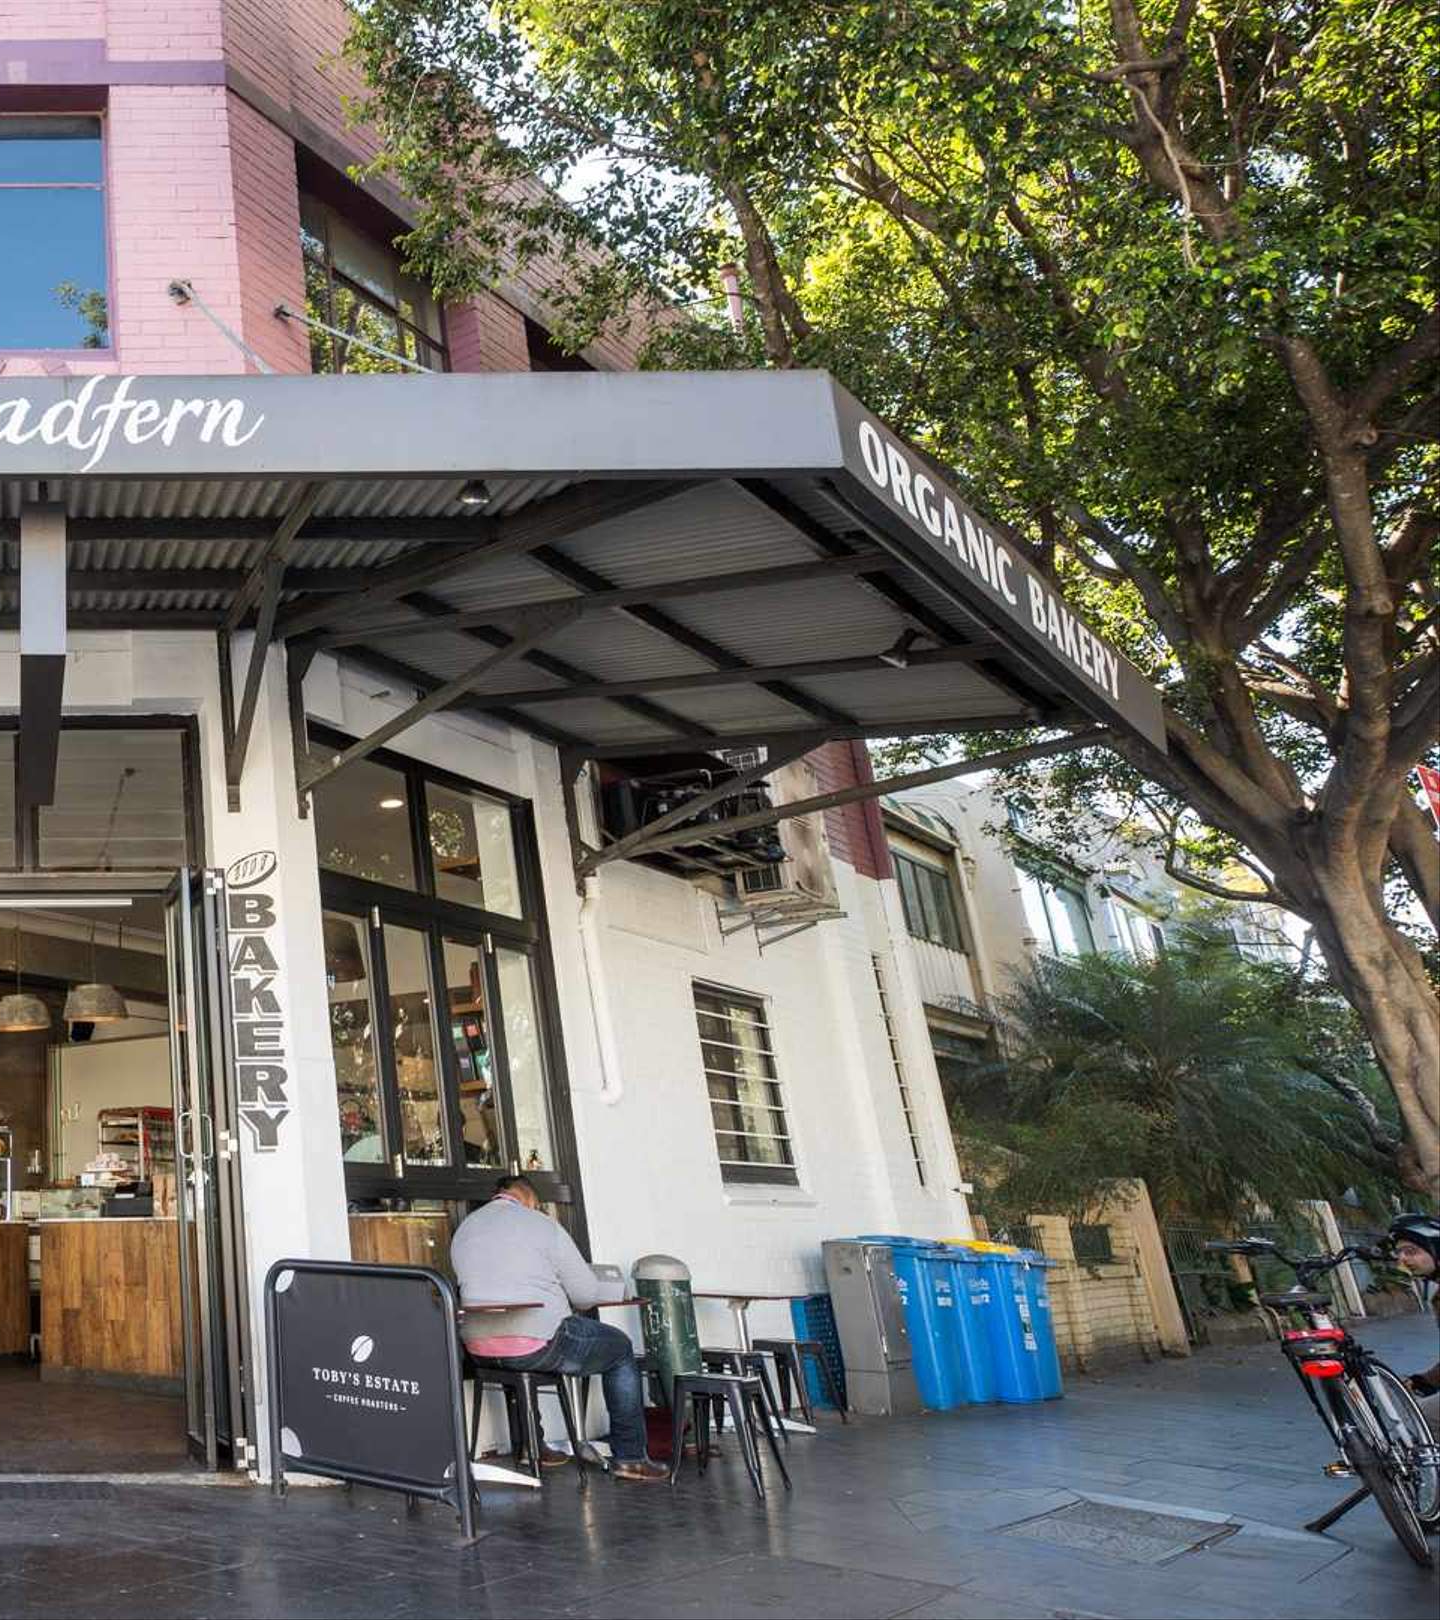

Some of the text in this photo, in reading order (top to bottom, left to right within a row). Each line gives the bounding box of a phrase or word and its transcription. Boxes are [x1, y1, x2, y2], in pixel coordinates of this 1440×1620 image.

[858, 419, 1121, 701] ORGANIC BAKERY
[226, 893, 289, 1153] BAKERY
[312, 1367, 420, 1395] TOBY'S ESTATE
